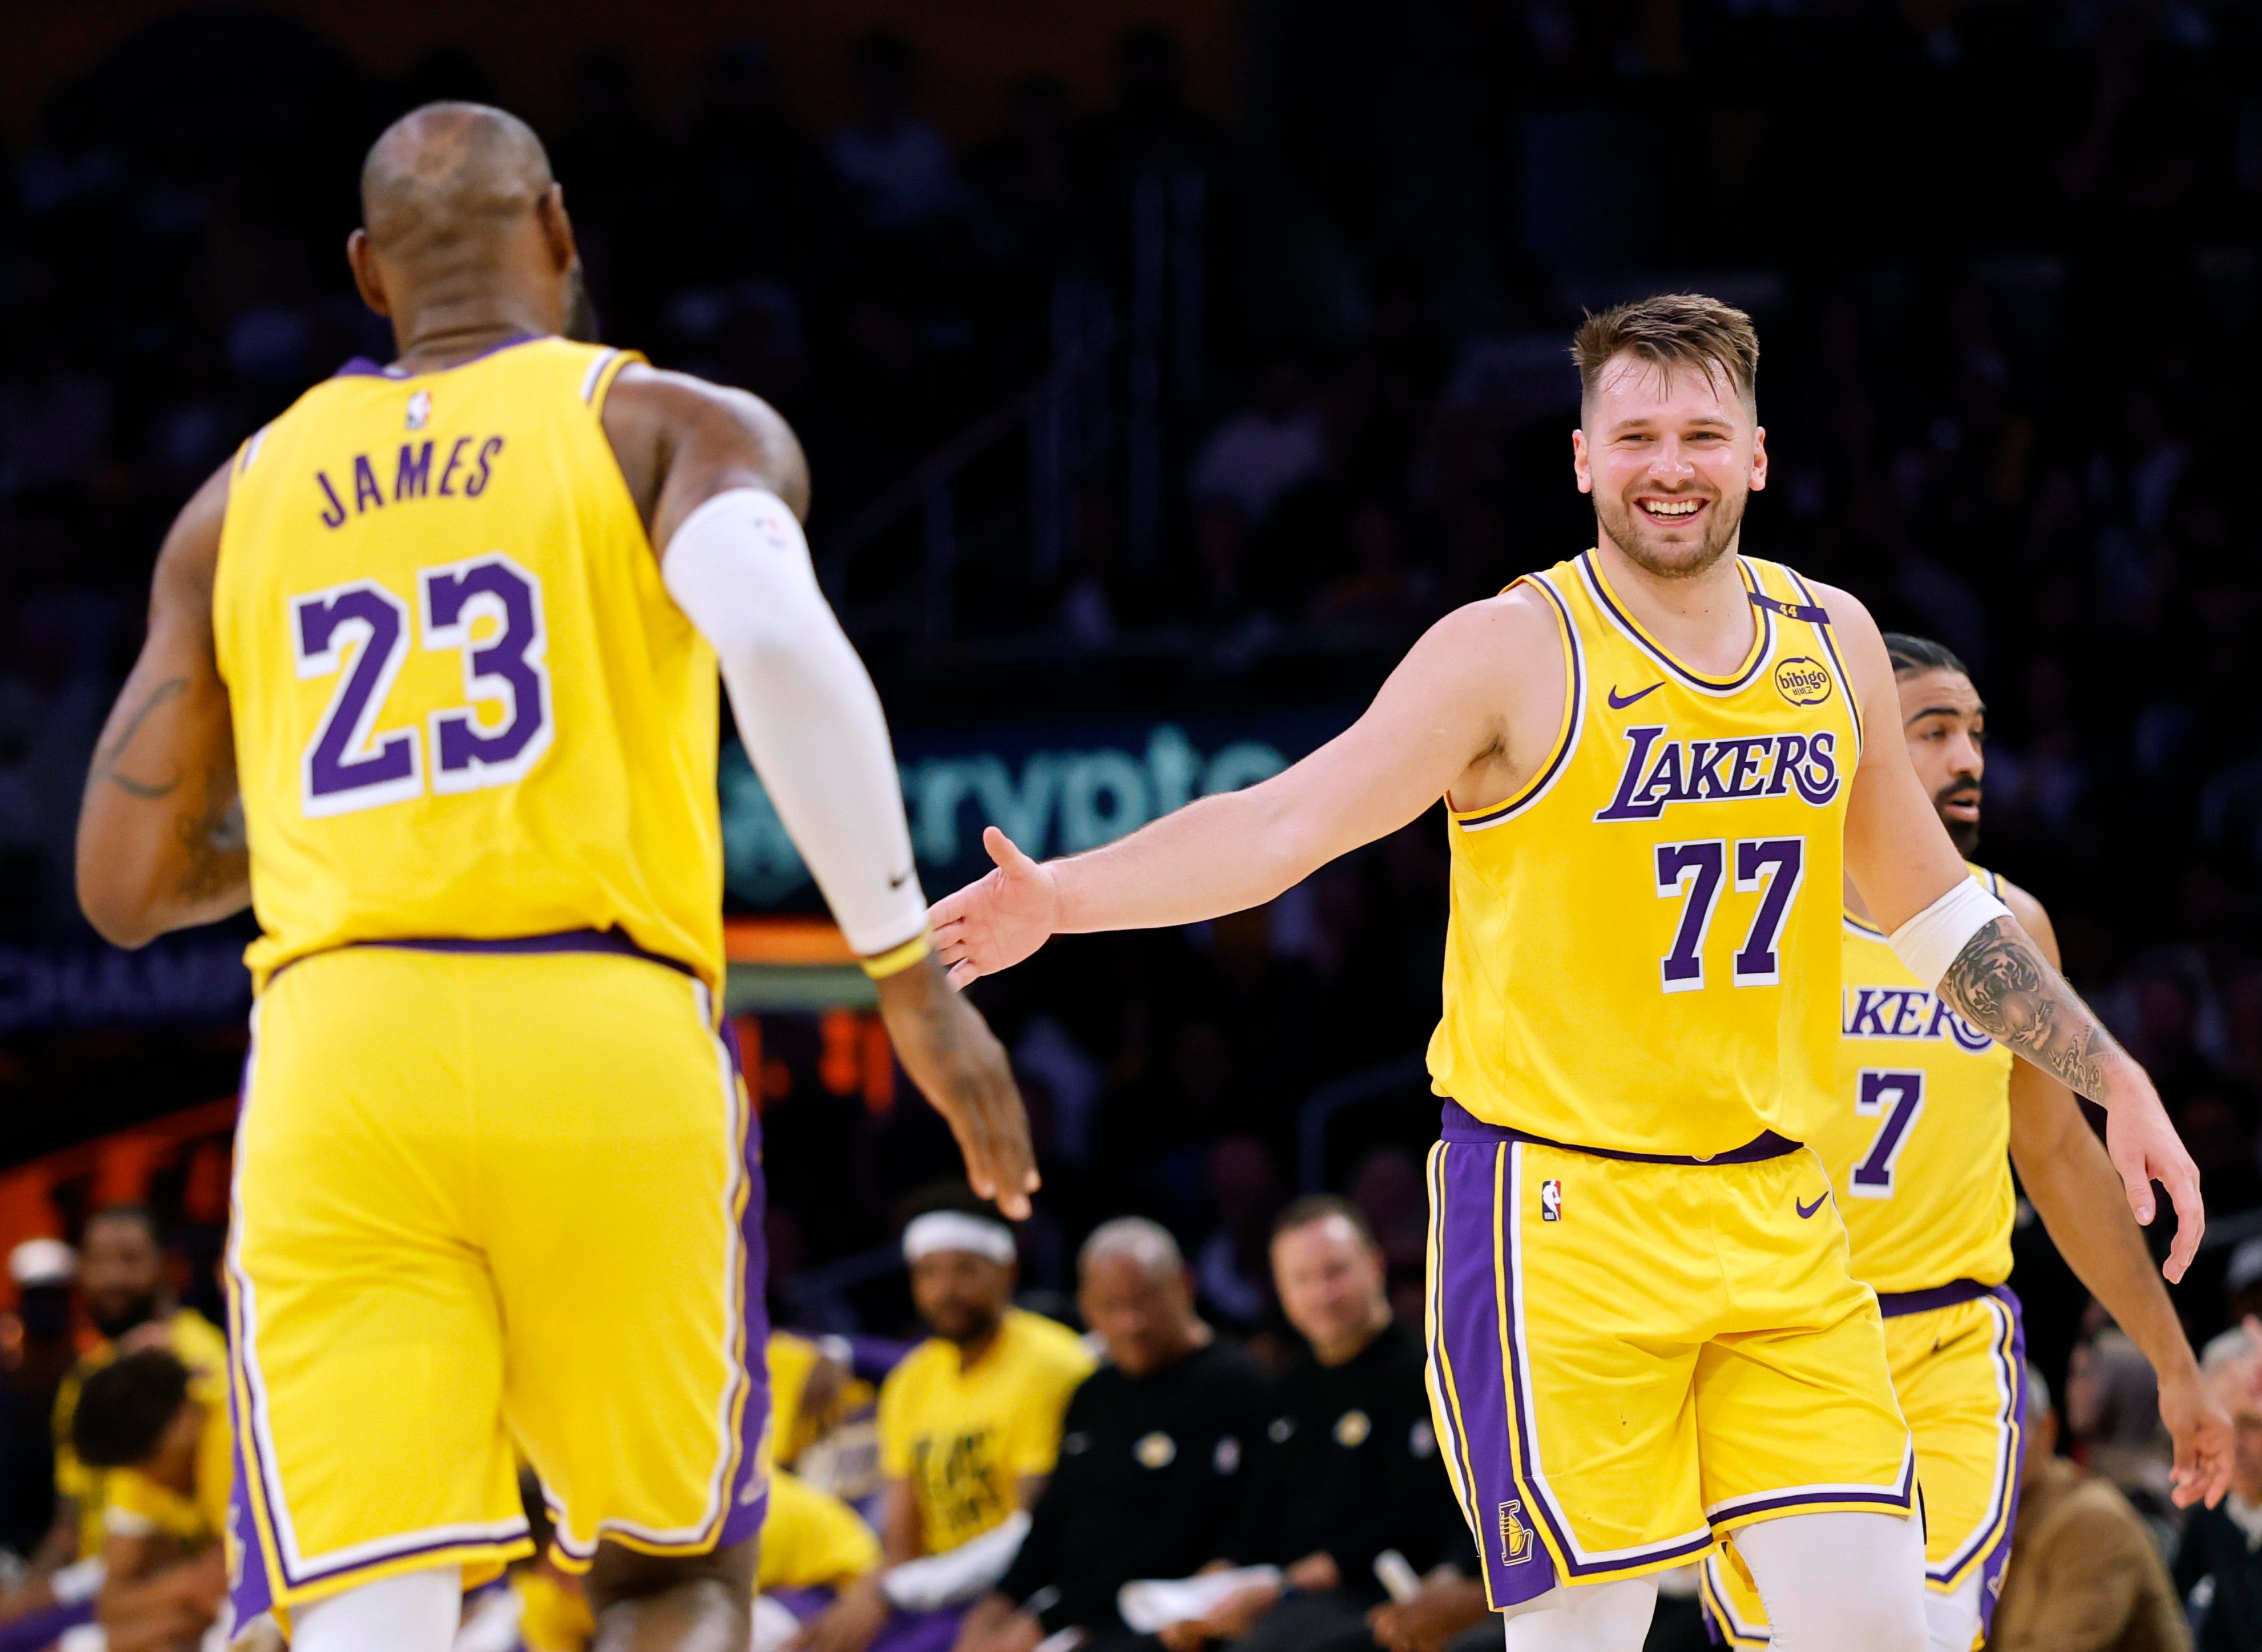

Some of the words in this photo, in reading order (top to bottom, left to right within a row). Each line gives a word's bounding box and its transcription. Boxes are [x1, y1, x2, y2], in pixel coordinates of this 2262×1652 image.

[315, 435, 503, 529] JAMES
[1779, 604, 1797, 617] 44
[291, 551, 555, 819] 23
[1779, 670, 1827, 689] bibigo
[901, 722, 1290, 865] rypt
[1591, 724, 1842, 823] LAKERS
[1654, 835, 1806, 994] 77
[1843, 985, 1994, 1055] KER
[1849, 1067, 1925, 1199] 7
